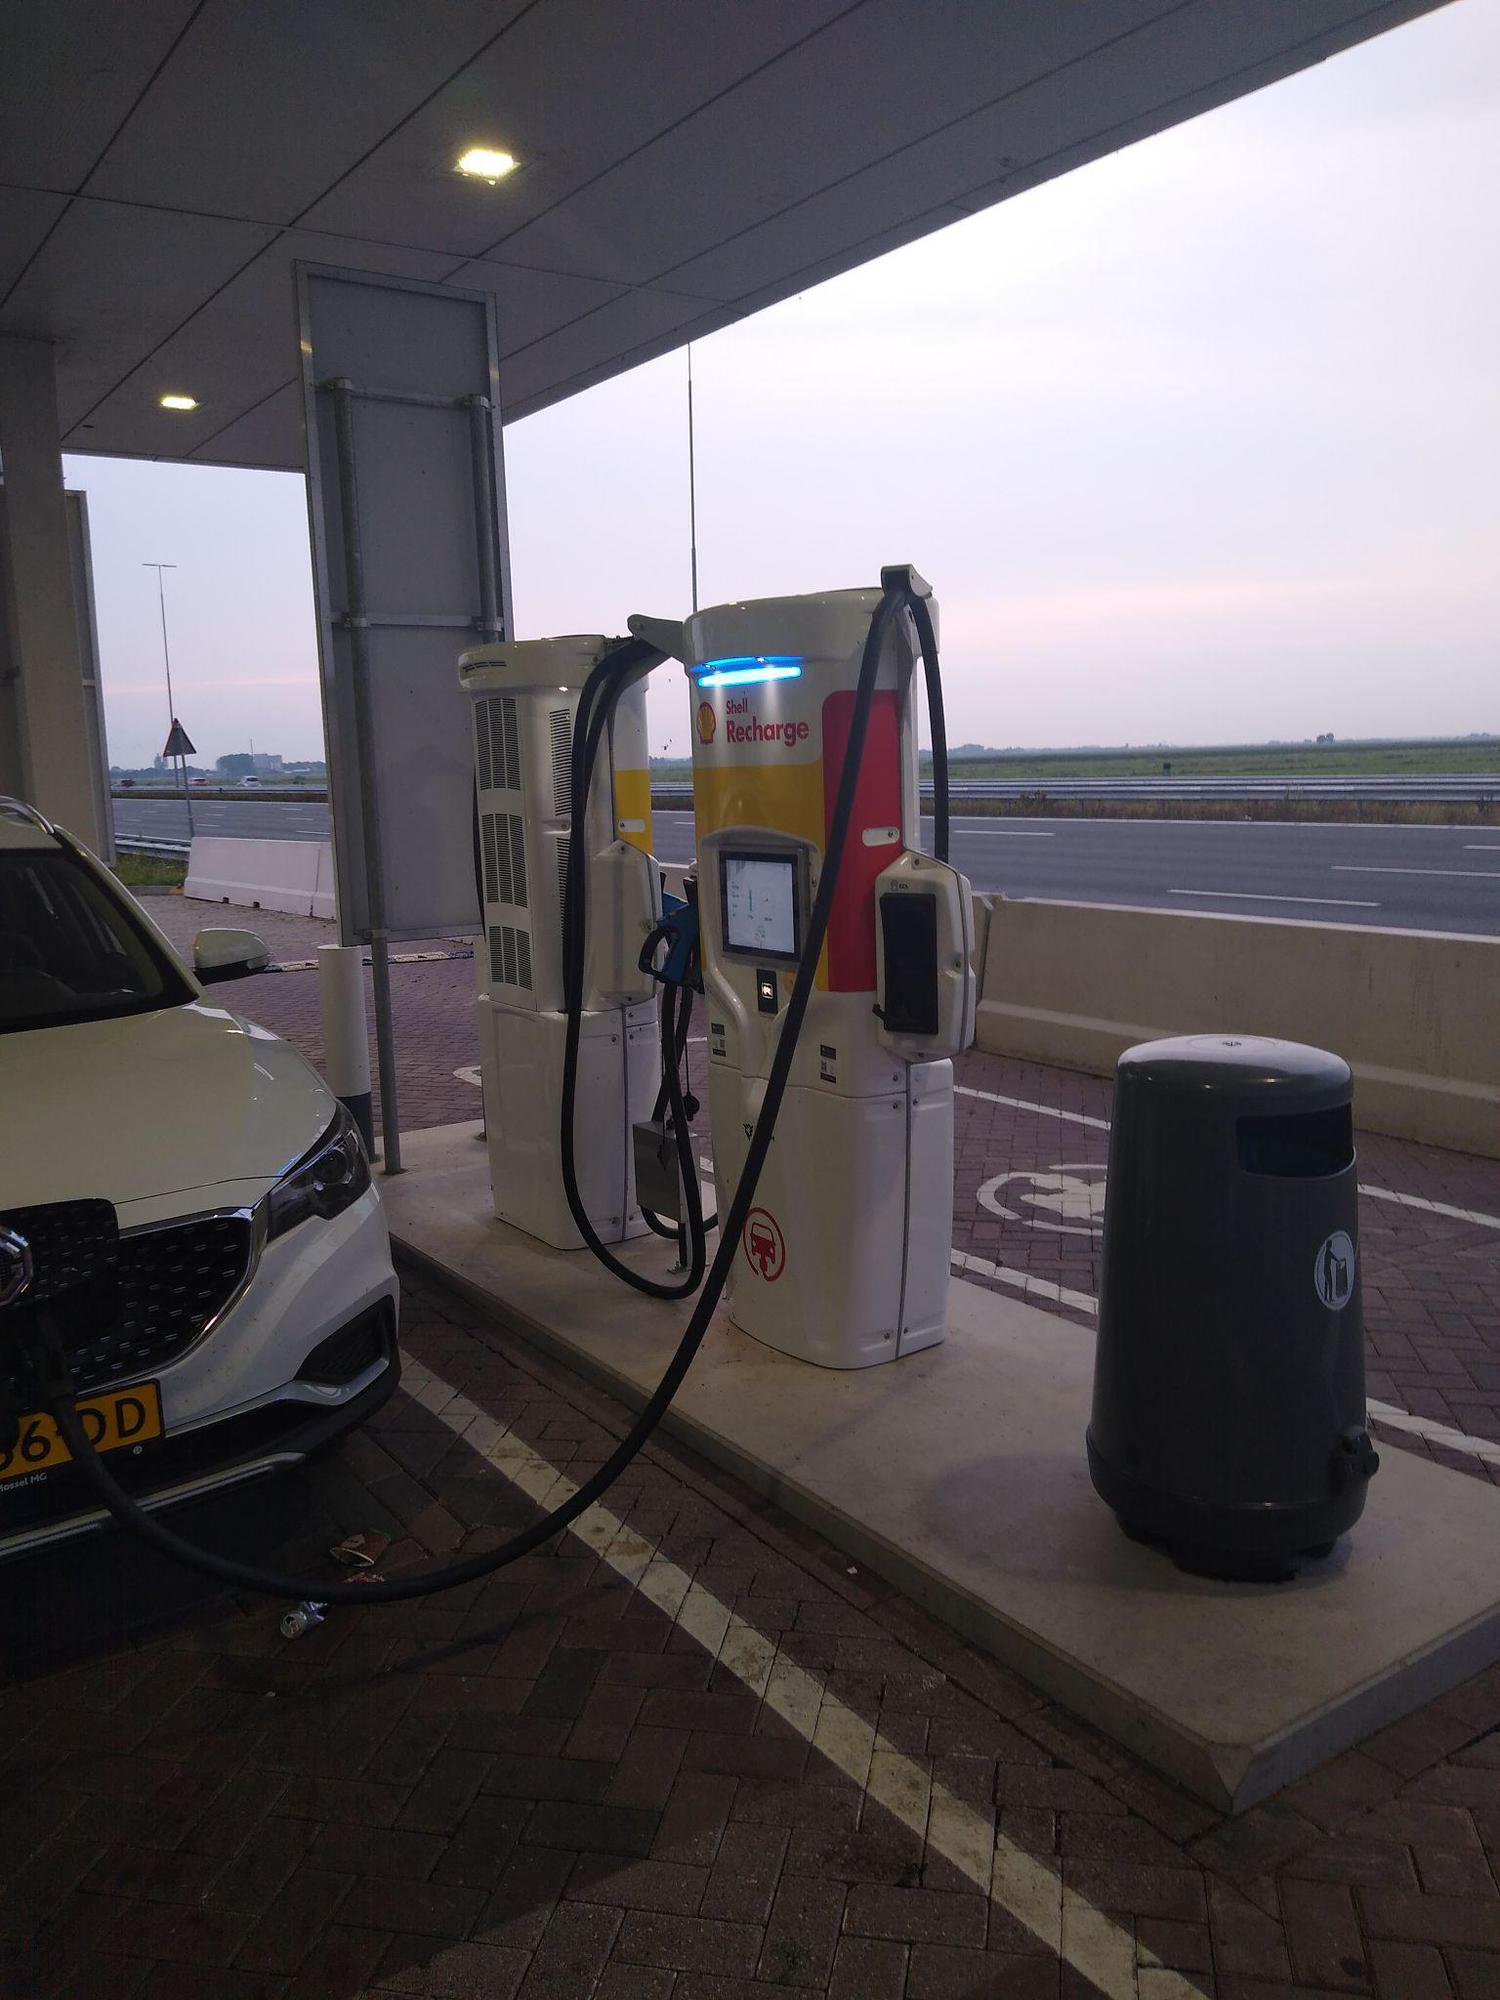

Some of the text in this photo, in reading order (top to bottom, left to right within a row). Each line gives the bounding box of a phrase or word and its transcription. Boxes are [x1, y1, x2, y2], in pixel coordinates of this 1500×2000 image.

[726, 698, 748, 714] Shell
[726, 716, 809, 747] Recharge
[30, 1472, 47, 1484] MG
